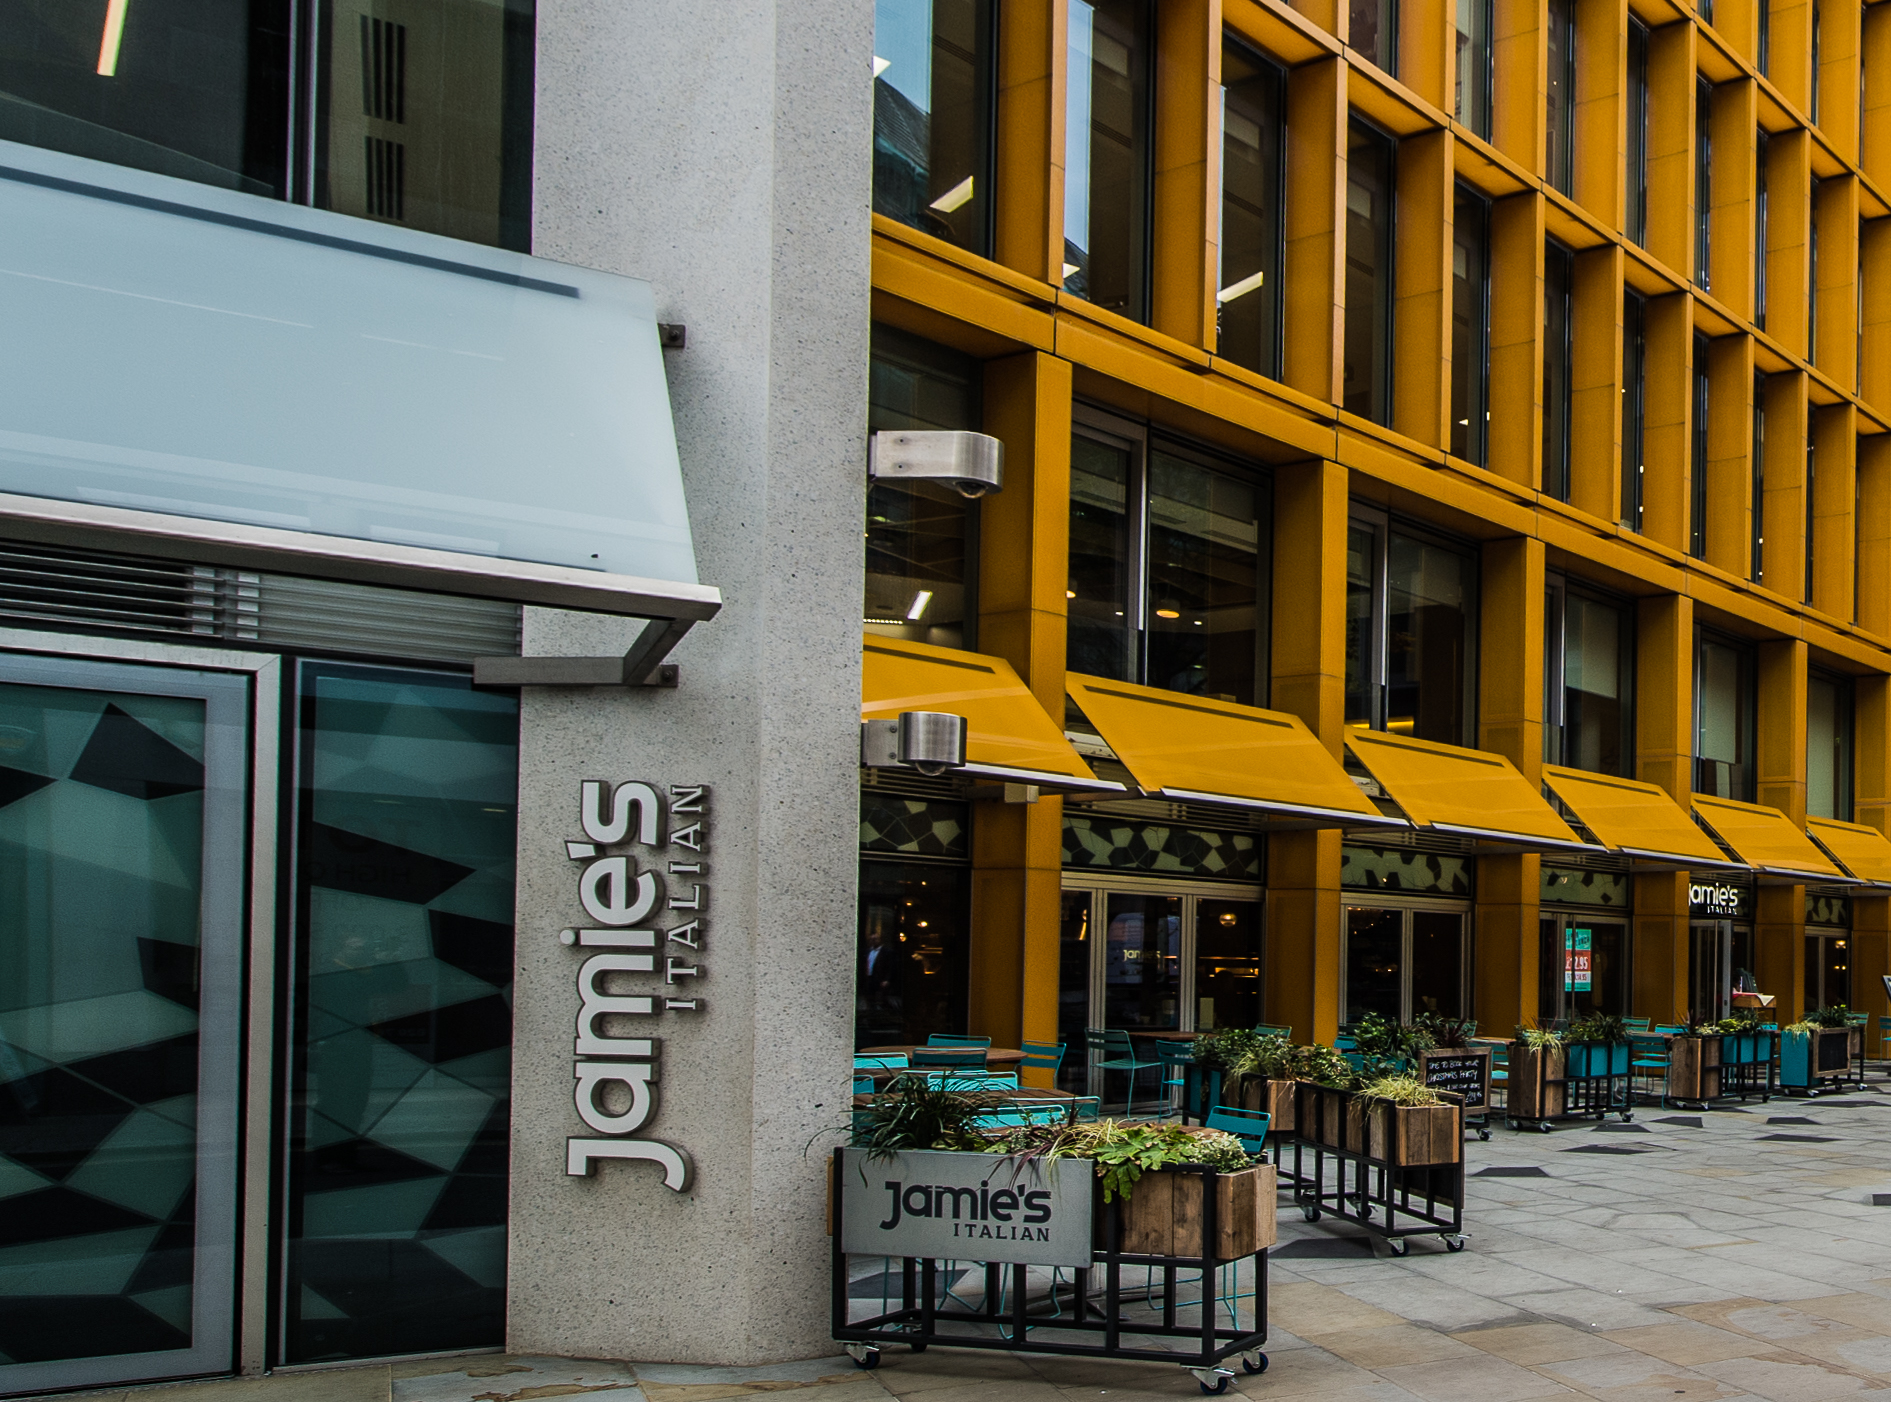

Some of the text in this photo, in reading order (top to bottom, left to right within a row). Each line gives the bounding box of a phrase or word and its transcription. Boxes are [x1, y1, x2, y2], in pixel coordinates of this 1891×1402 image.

[665, 784, 704, 1011] ITALIAN
[559, 779, 687, 1193] Jamie's
[878, 1180, 1052, 1231] Jamie's
[953, 1222, 1050, 1242] ITALIAN
